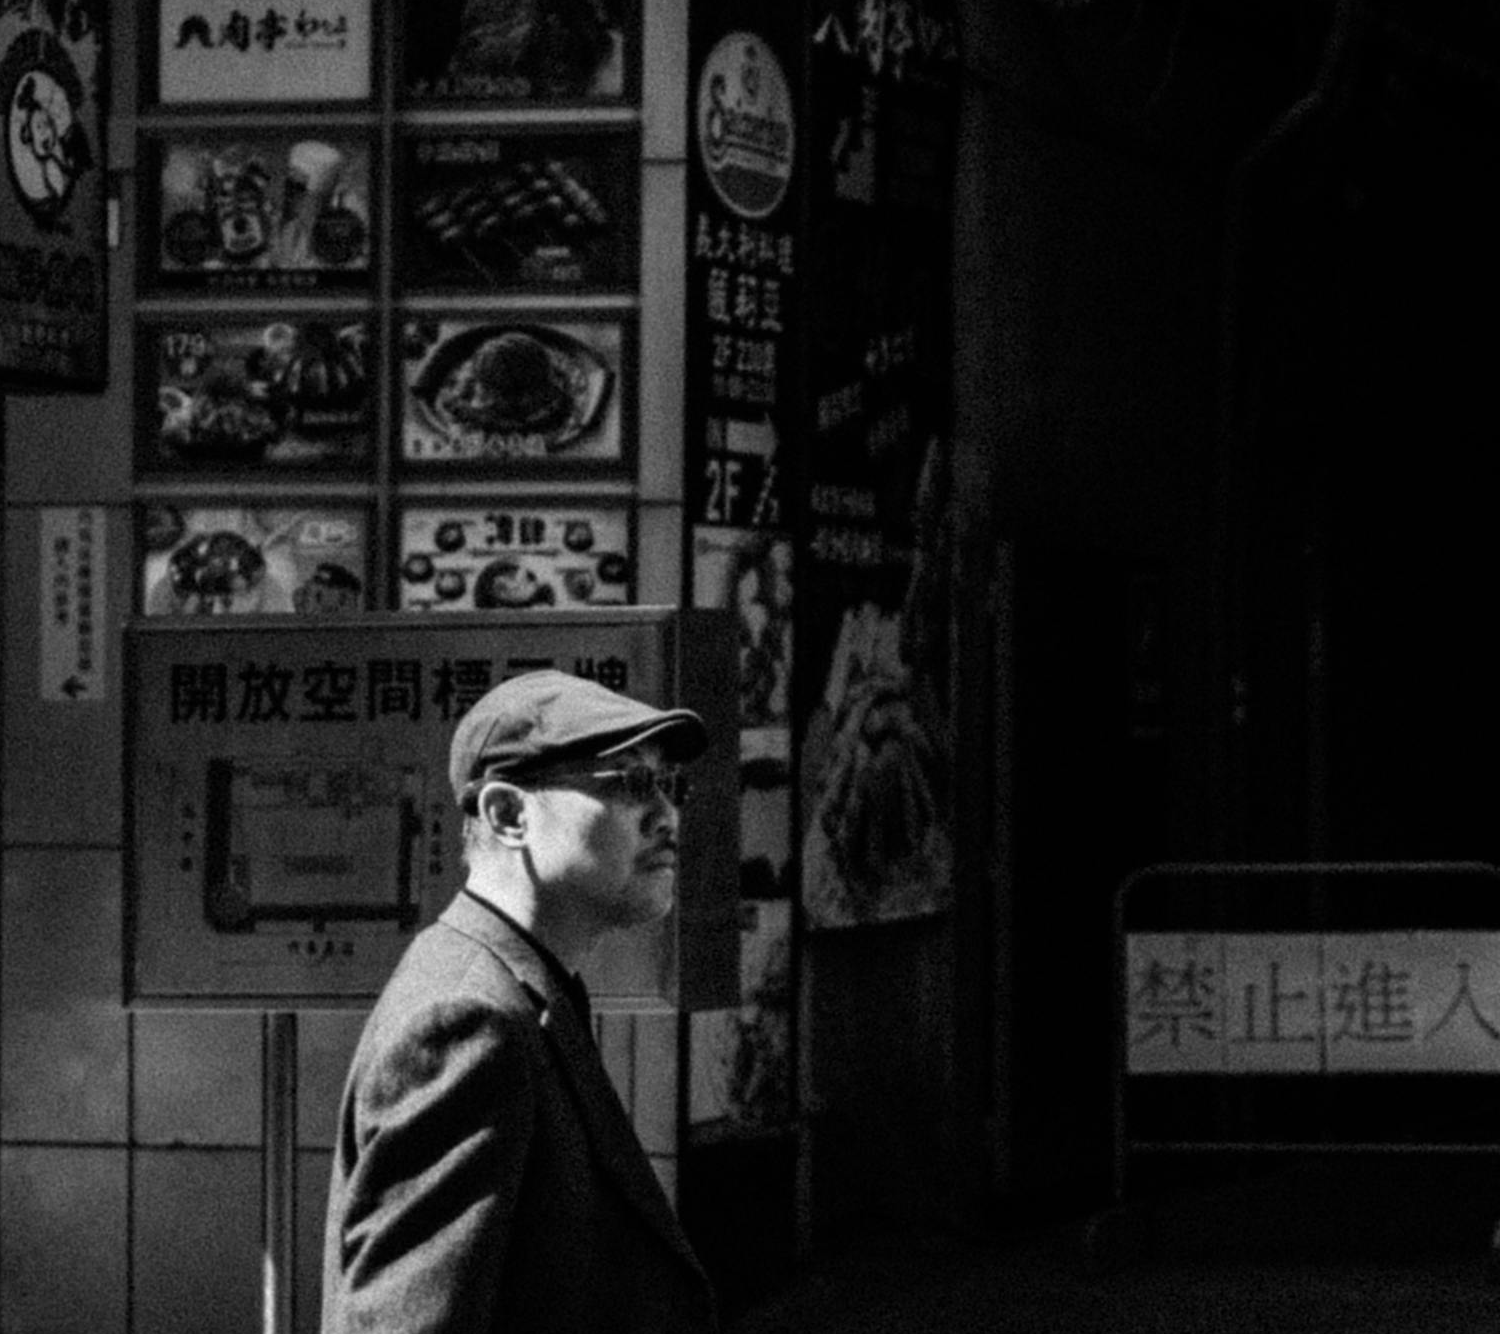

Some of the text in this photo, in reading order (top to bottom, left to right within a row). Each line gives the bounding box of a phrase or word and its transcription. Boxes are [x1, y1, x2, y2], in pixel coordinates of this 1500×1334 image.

[168, 656, 630, 723] 開放空間標
